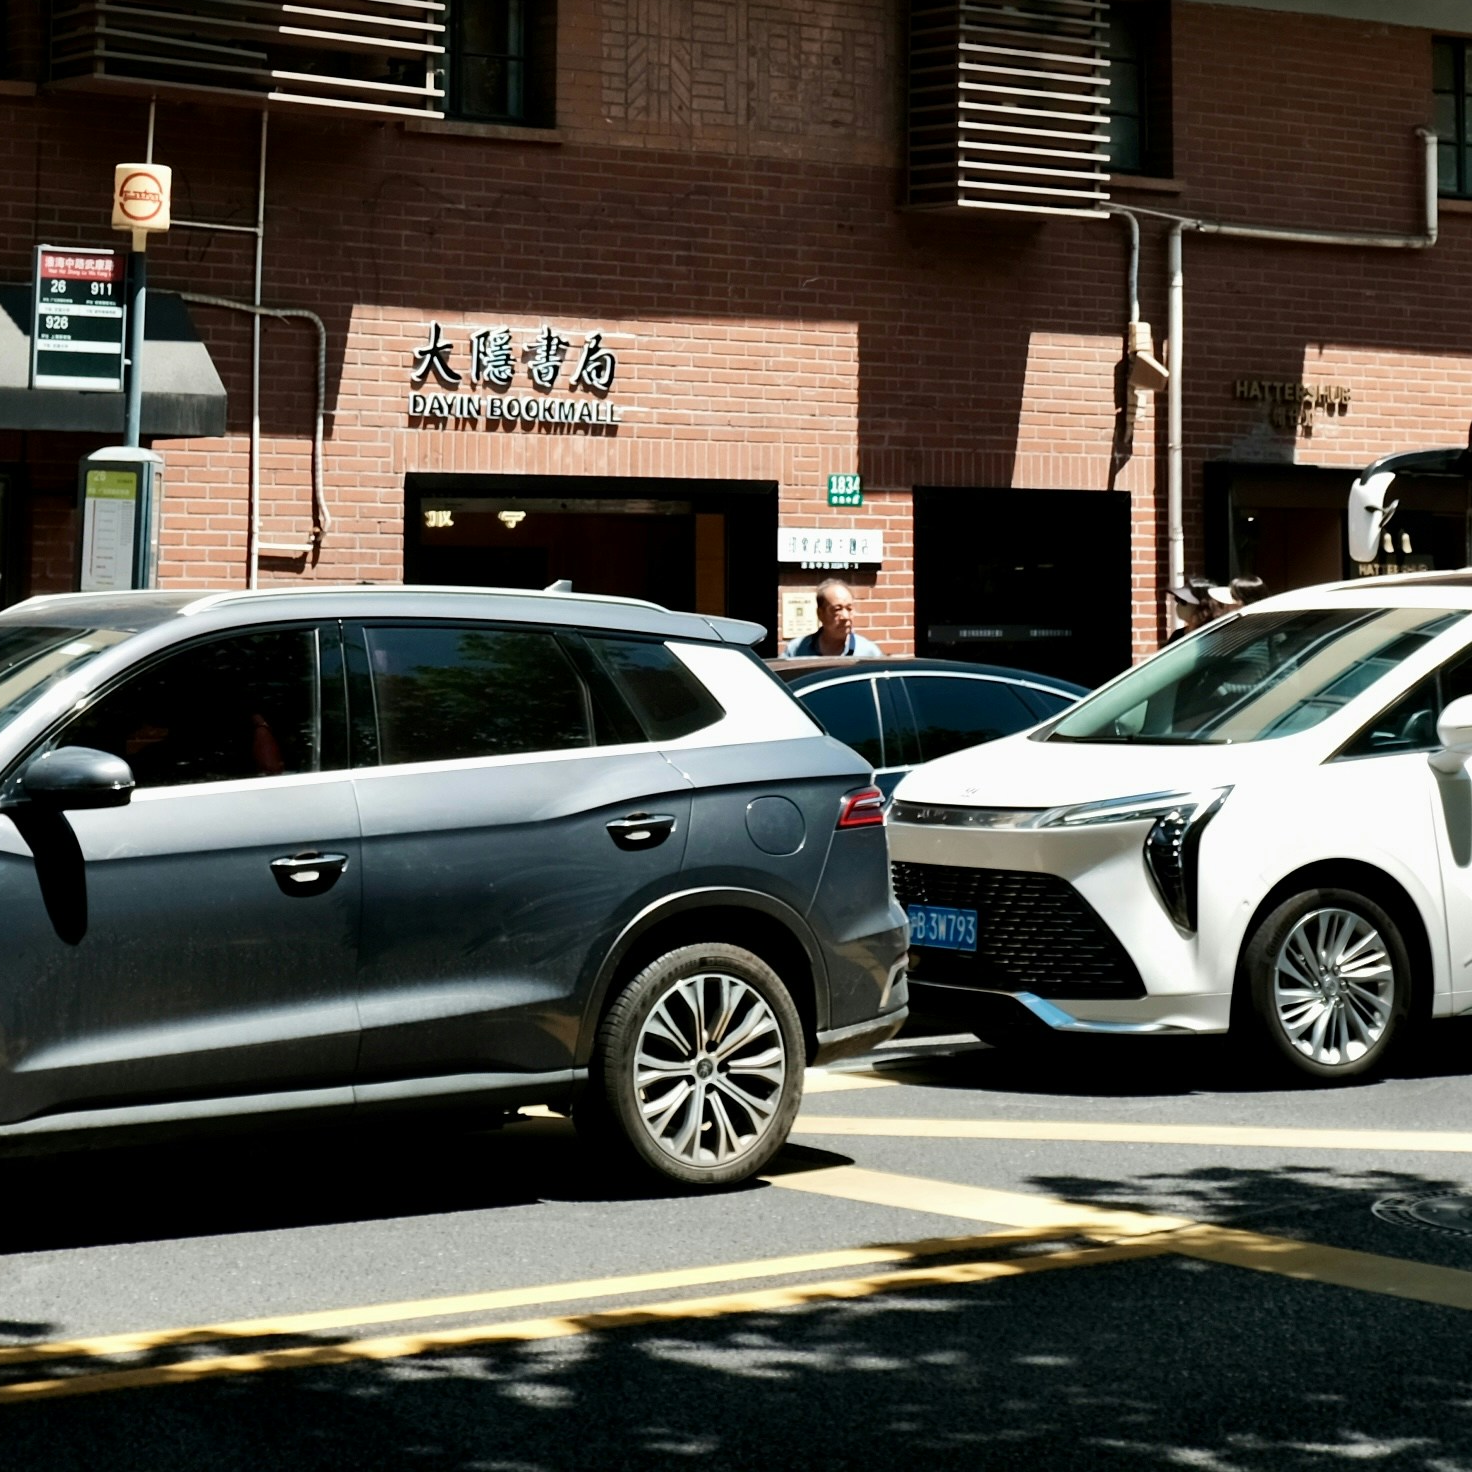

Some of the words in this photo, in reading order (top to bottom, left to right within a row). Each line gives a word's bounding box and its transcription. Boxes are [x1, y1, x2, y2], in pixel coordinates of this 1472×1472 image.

[50, 280, 67, 293] 26
[91, 282, 112, 296] 911
[45, 316, 69, 330] 926
[408, 392, 482, 419] DAYIN
[486, 395, 622, 425] BOOKMALL
[830, 476, 861, 495] 1834
